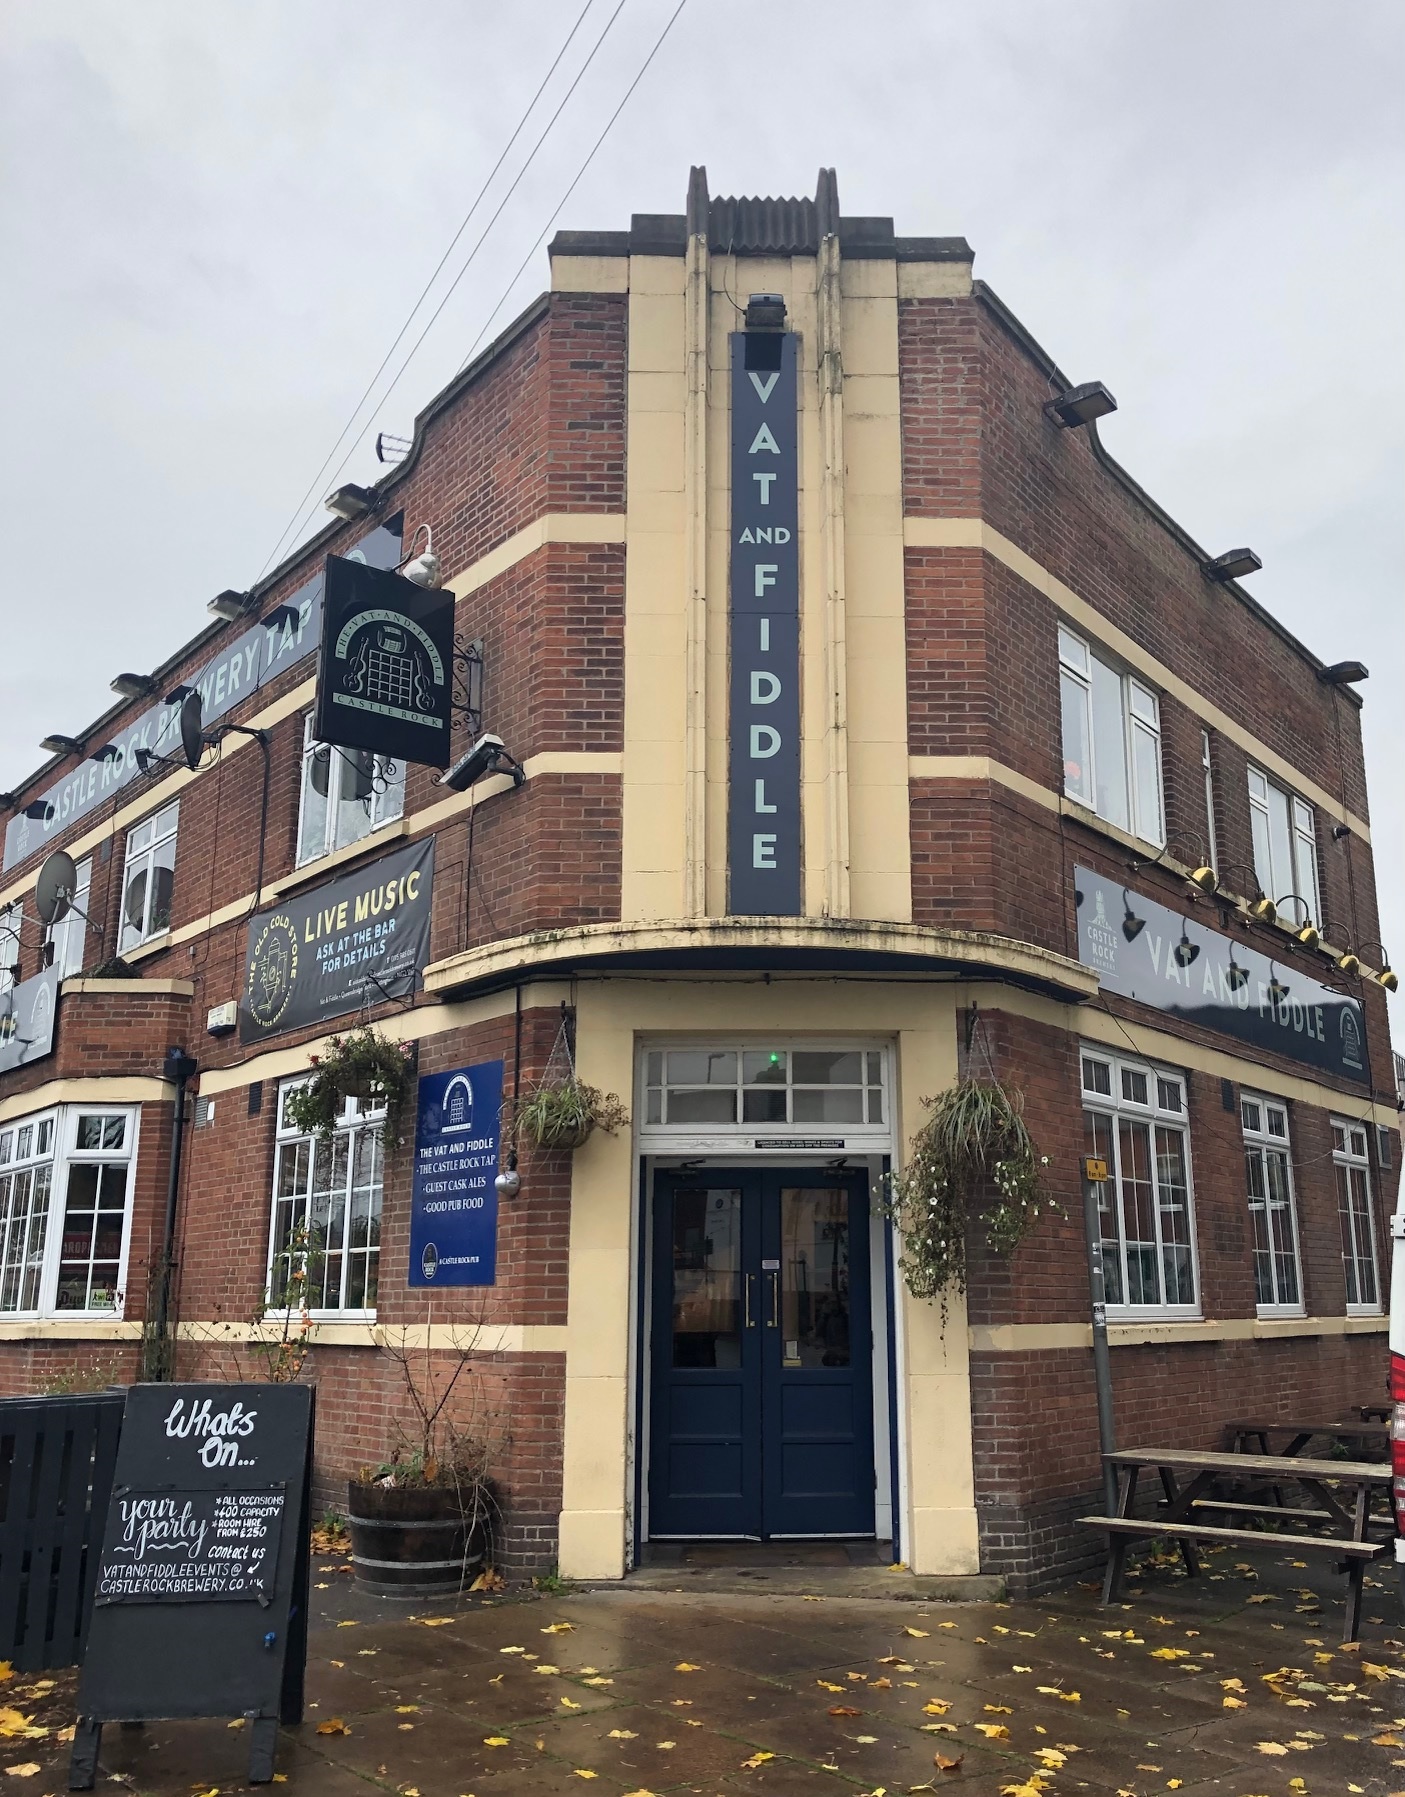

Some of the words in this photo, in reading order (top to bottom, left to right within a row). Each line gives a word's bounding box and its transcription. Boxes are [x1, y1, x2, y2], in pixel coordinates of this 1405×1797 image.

[748, 373, 780, 504] VAT
[739, 527, 790, 544] AND
[338, 630, 350, 656] THE
[352, 612, 375, 626] VAT
[384, 612, 410, 627] AND
[418, 631, 442, 680] FIDDLE
[43, 764, 98, 831] CASTLE
[102, 722, 152, 790] ROCK
[157, 638, 259, 748] BRWERY
[267, 599, 312, 666] TAP
[338, 696, 392, 715] CASTLE
[402, 709, 438, 726] ROCK
[750, 565, 782, 868] FIDDLE
[305, 901, 348, 943] LIVE
[354, 871, 420, 923] MUSIC
[316, 942, 334, 960] ASK
[338, 936, 349, 952] AT
[353, 927, 371, 946] THE
[375, 919, 395, 938] BAR
[1088, 926, 1117, 948] CASTLE
[248, 961, 256, 995] THE
[255, 927, 268, 955] OLD
[270, 915, 289, 930] COLD
[288, 926, 298, 978] STORE
[322, 957, 340, 975] FOR
[344, 939, 386, 967] DETAILS
[1092, 942, 1115, 962] ROCK
[1145, 931, 1190, 988] VAT
[1203, 958, 1249, 1010] AND
[1258, 981, 1325, 1042] FIDDLE
[420, 1147, 432, 1158] THE
[434, 1145, 448, 1156] VAT
[449, 1143, 465, 1154] AND
[467, 1138, 494, 1151] FIDDLE
[419, 1164, 432, 1174] THE
[433, 1160, 458, 1173] CASTLE
[459, 1157, 480, 1169] ROCK
[481, 1155, 496, 1166] TAP
[426, 1181, 447, 1193] GUEST
[448, 1178, 467, 1191] CASK
[468, 1177, 486, 1188] ALES
[426, 1201, 447, 1213] GOOD
[448, 1200, 461, 1211] PUB
[463, 1197, 484, 1209] FOOD
[443, 1257, 457, 1265] CASTLE
[164, 1399, 257, 1438] Whats
[198, 1436, 254, 1467] On...
[239, 1496, 284, 1505] OCCASIONS
[240, 1507, 279, 1517] CAPACITY
[120, 1498, 177, 1541] your
[134, 1501, 208, 1560] party
[217, 1529, 238, 1537] FROM
[240, 1526, 267, 1538] £250
[218, 1519, 241, 1527] ROOM
[243, 1518, 262, 1527] HIRE
[252, 1548, 266, 1558] us
[104, 1563, 242, 1578] VATANDFIDDLEEVENTS@
